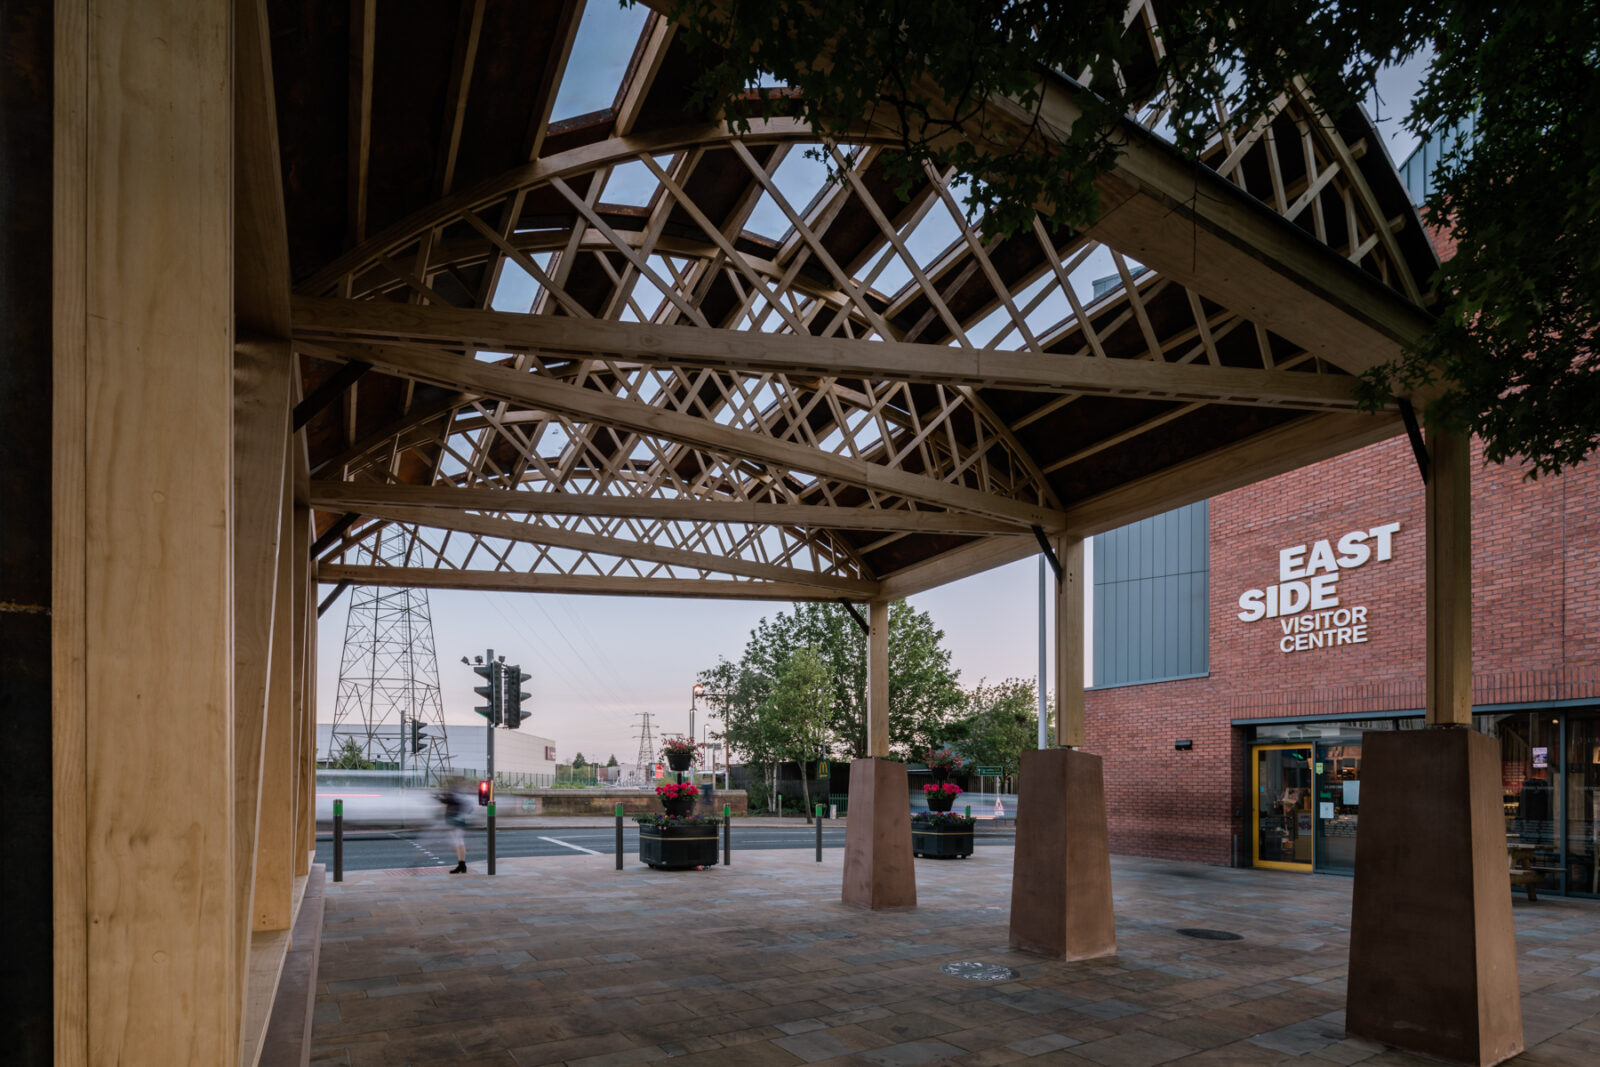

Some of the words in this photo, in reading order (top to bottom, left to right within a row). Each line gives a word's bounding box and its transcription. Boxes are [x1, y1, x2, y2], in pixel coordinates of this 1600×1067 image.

[1280, 522, 1400, 582] EAST
[1237, 573, 1339, 622] SIDE
[1280, 606, 1367, 634] VISITOR
[1280, 624, 1368, 652] CENTRE
